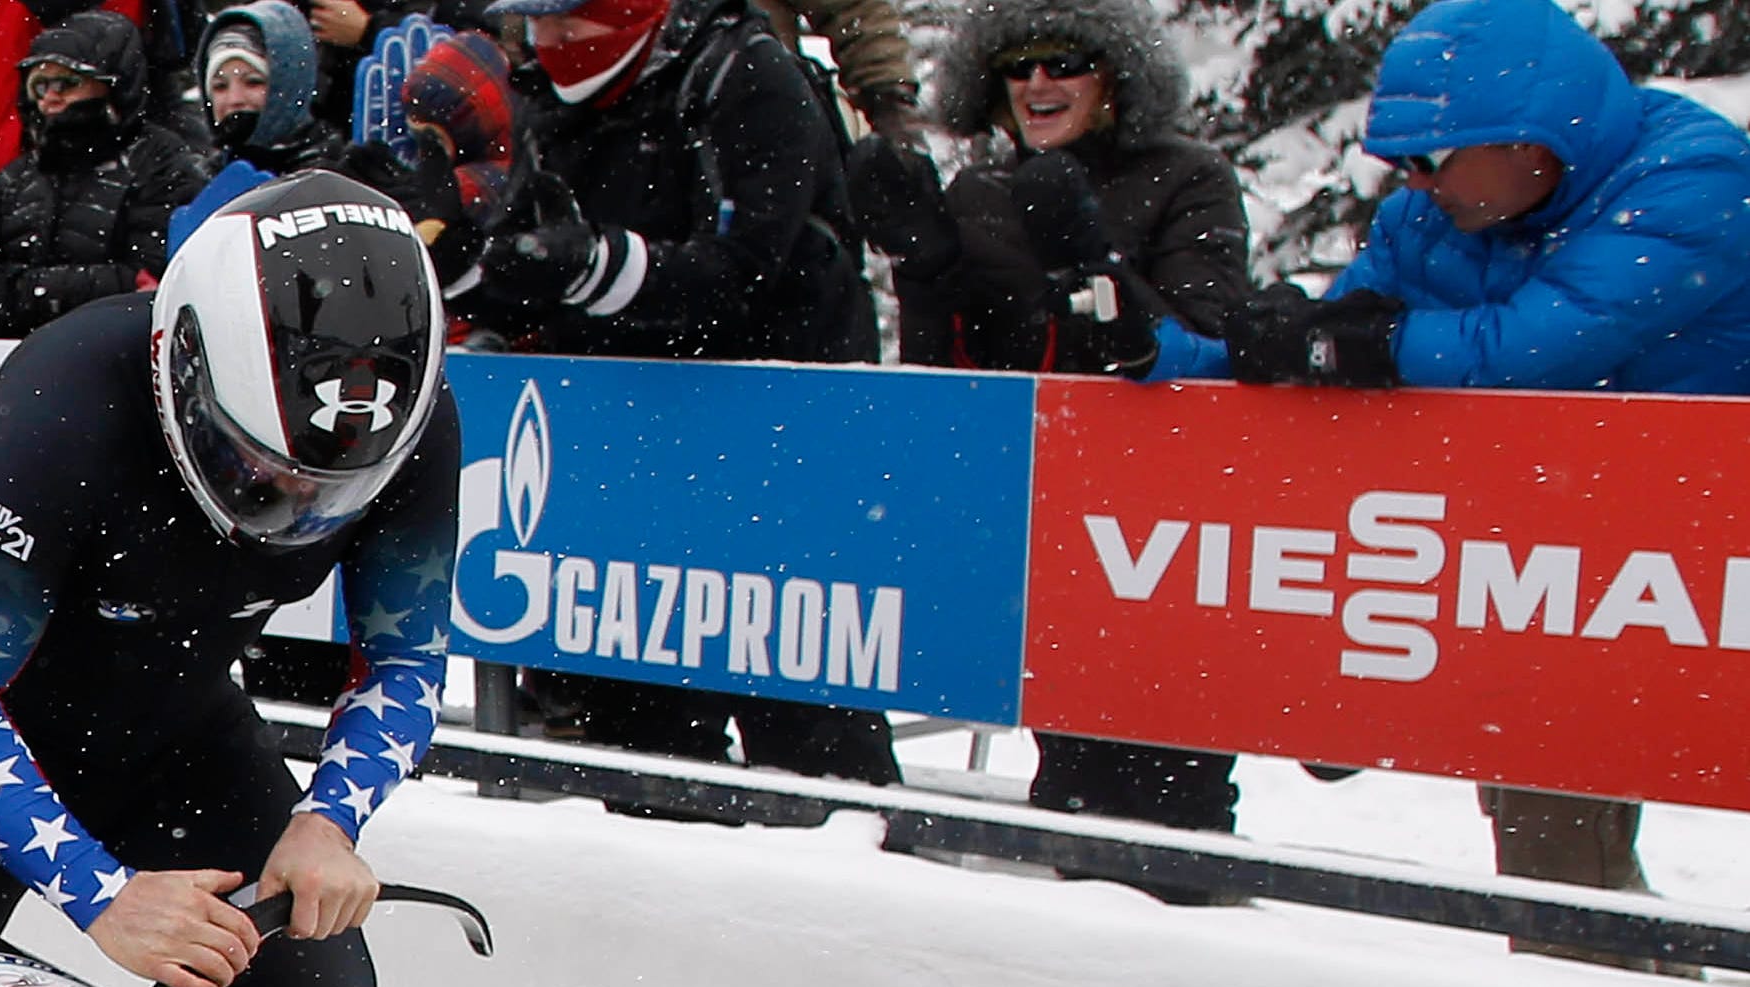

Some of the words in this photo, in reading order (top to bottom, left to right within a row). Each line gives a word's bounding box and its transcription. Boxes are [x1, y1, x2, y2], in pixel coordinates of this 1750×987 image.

[257, 204, 412, 250] WHELEN
[1, 526, 35, 562] 21
[1083, 490, 1750, 682] VIESSMA
[554, 555, 904, 693] GAZPROM
